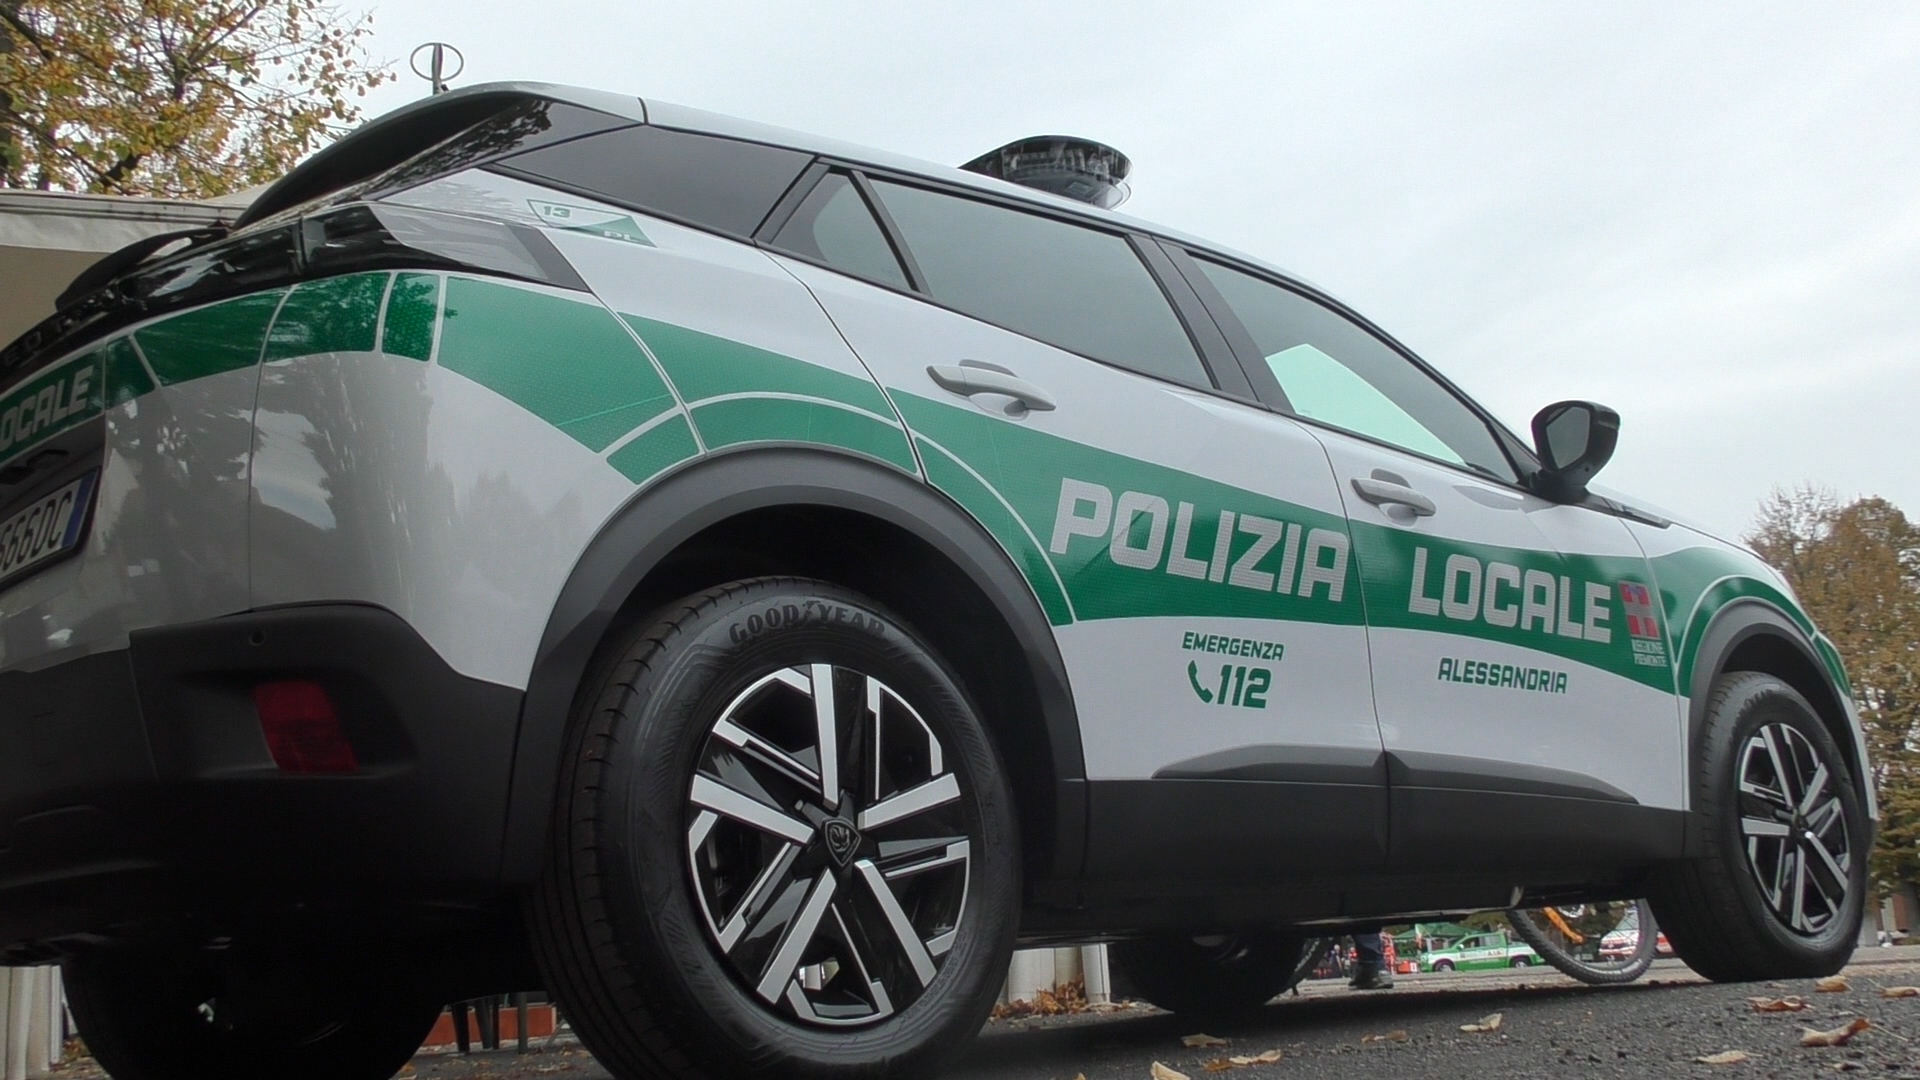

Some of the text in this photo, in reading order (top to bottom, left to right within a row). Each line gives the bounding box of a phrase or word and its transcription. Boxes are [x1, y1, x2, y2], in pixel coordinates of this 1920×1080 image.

[543, 205, 571, 219] 13
[603, 230, 639, 243] PL
[1049, 477, 1611, 644] POLIZIA LOCALE
[728, 601, 885, 645] GOODYEAR
[1181, 631, 1285, 661] EMERGENZA
[1216, 664, 1272, 708] 112
[1437, 657, 1568, 694] ALESSANDRIA
